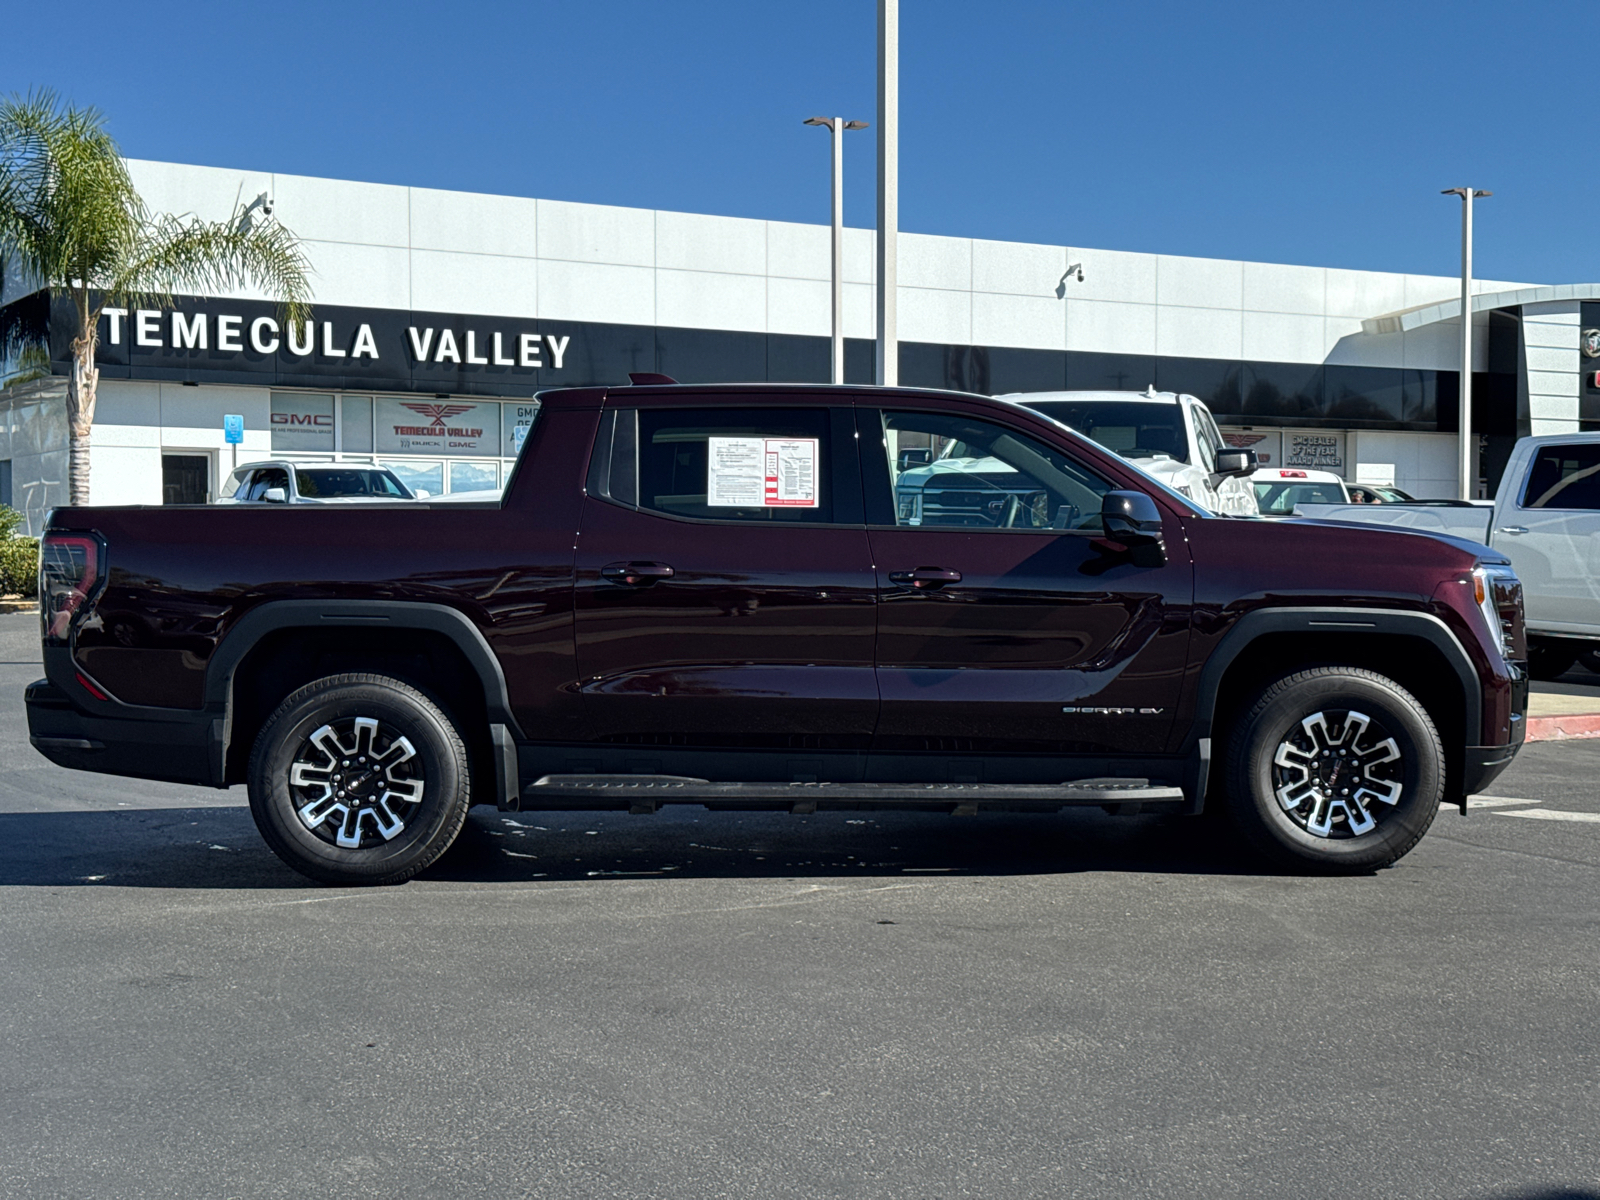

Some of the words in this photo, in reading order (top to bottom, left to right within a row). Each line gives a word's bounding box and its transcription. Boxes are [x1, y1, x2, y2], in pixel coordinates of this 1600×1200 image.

[101, 307, 379, 359] TEMECULA
[408, 326, 570, 369] VALLEY
[271, 413, 332, 426] GMC
[393, 425, 445, 437] TEMECULA
[447, 427, 483, 438] VALLEY
[448, 441, 477, 449] GMC
[1292, 435, 1309, 445] GMC
[1309, 436, 1337, 446] DEALER
[1292, 446, 1303, 456] OF
[1303, 446, 1317, 456] THE
[1318, 446, 1337, 457] YEAR
[1287, 456, 1312, 466] AWARD
[1313, 457, 1342, 467] WINNER
